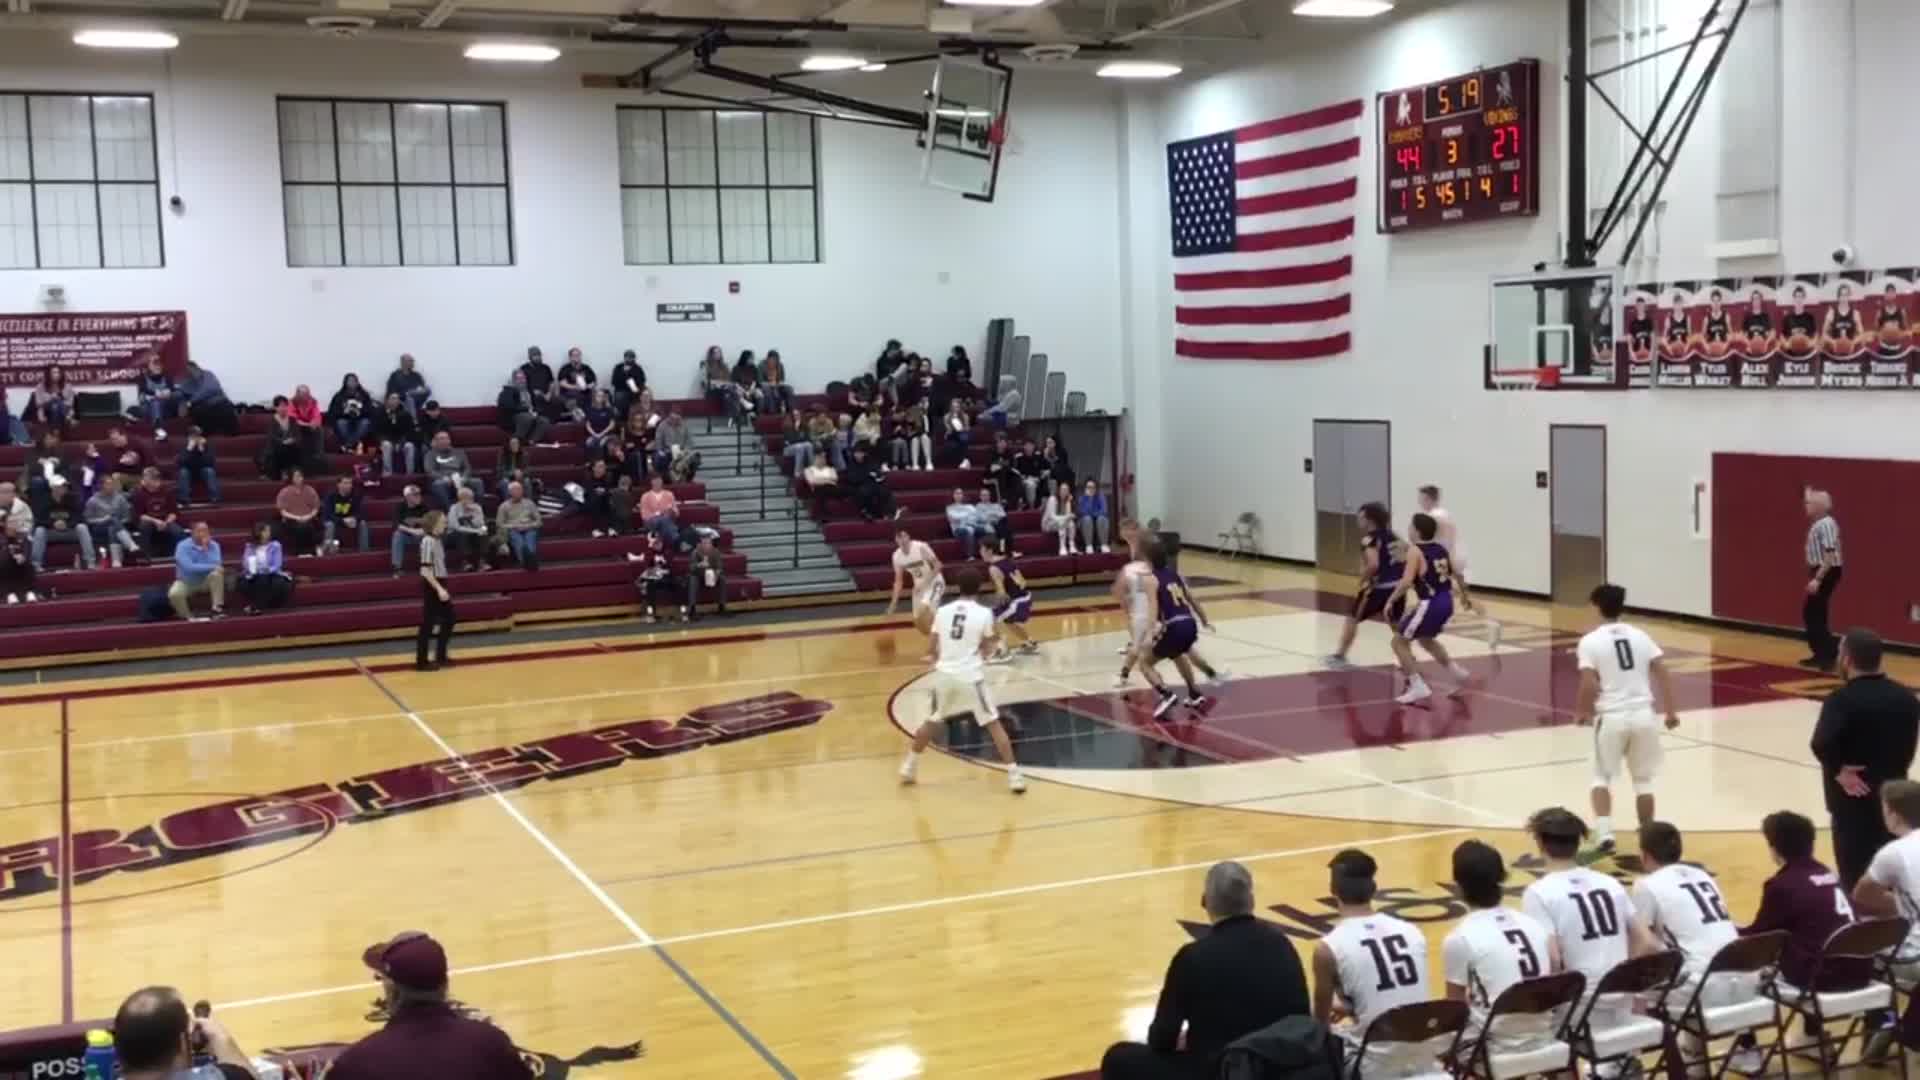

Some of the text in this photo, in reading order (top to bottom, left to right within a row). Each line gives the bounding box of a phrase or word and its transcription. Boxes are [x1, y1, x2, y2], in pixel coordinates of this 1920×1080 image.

[1396, 145, 1420, 171] 44
[1447, 140, 1458, 164] 3
[1492, 126, 1519, 159] 27
[1415, 186, 1426, 208] 5
[1480, 177, 1491, 198] 4
[72, 317, 138, 332] EVERYTHING
[949, 613, 967, 641] 5
[1614, 639, 1634, 671] 0
[1568, 887, 1619, 942] 10
[1834, 887, 1856, 923] 4
[1359, 933, 1419, 992] 15
[1503, 928, 1541, 978] 3
